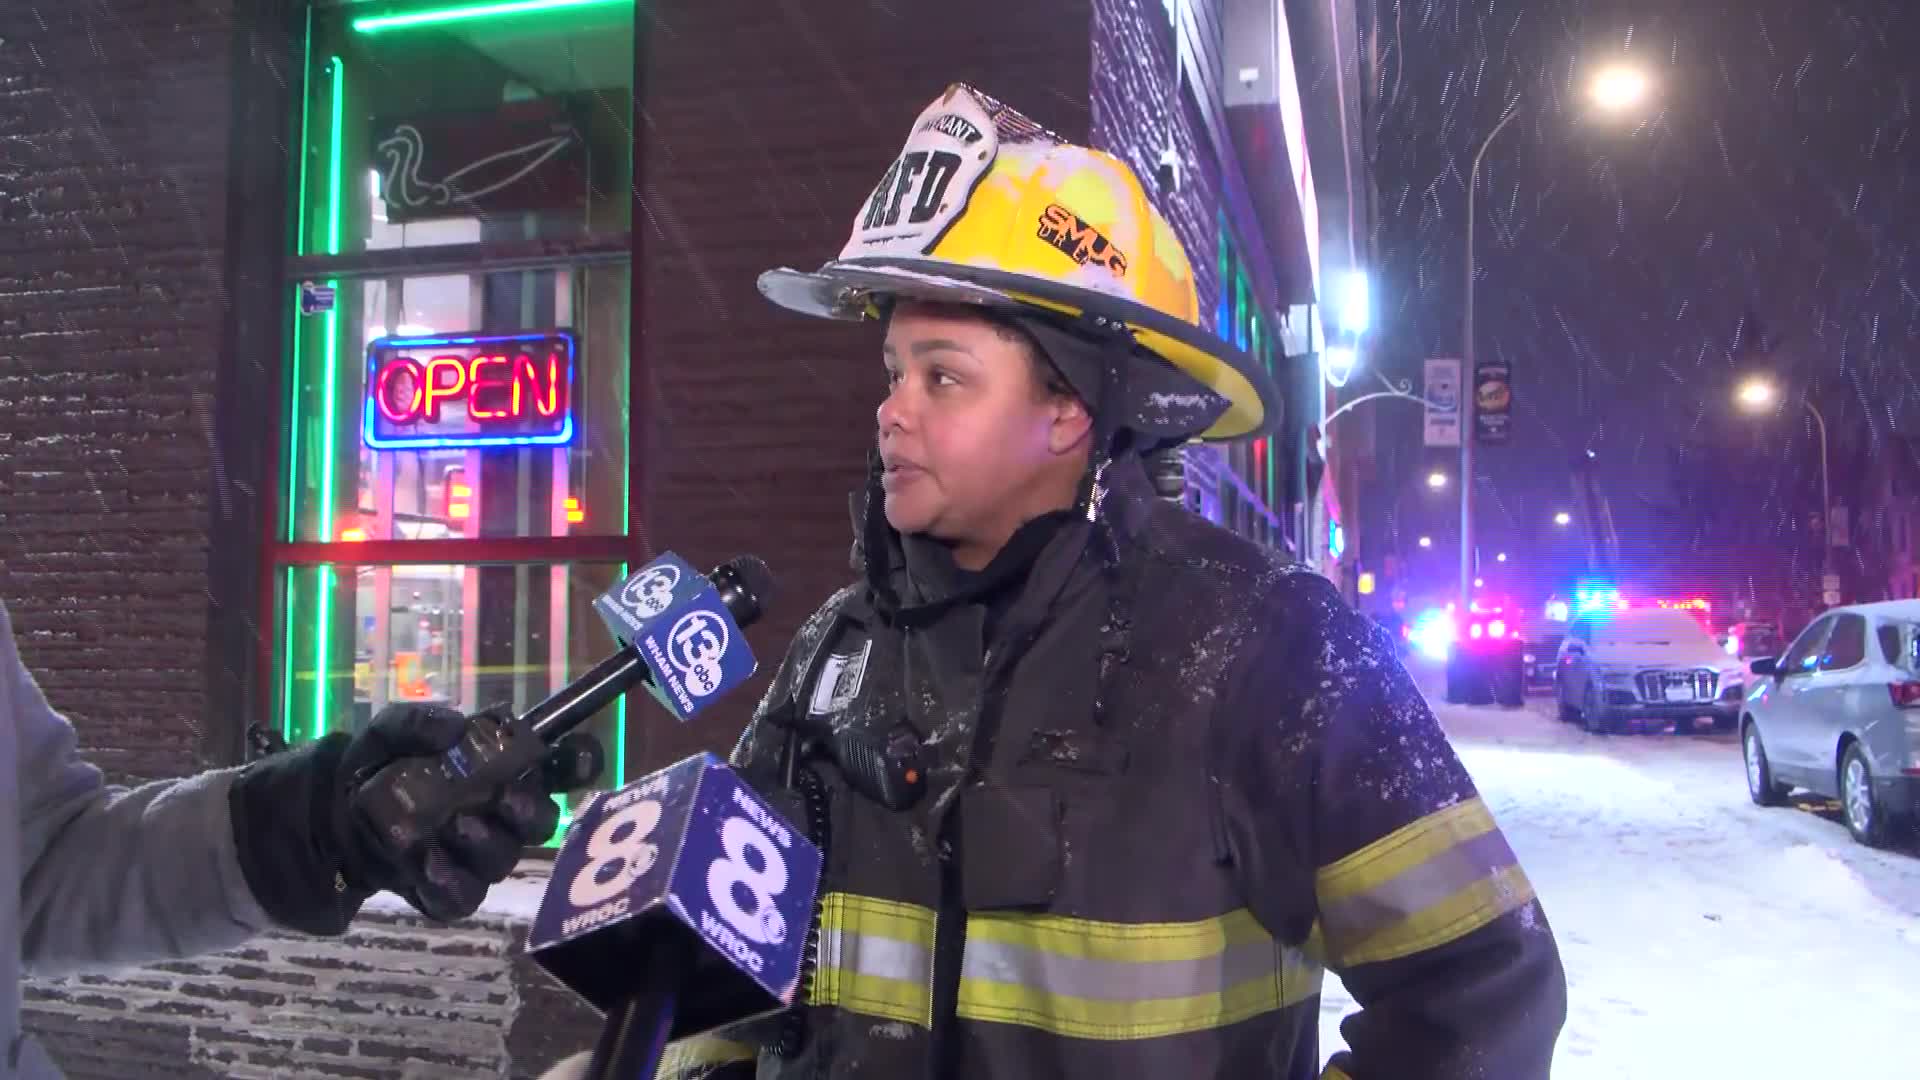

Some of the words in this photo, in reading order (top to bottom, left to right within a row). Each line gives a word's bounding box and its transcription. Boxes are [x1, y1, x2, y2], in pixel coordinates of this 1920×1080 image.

[377, 353, 557, 424] OPEN
[676, 615, 721, 668] 13
[645, 634, 672, 679] WHAM
[669, 675, 694, 713] NEWS
[694, 664, 714, 691] abc
[733, 787, 792, 848] NEWS
[568, 800, 662, 908] 8
[707, 816, 789, 945] 8
[562, 897, 631, 934] WROC
[700, 910, 764, 972] WROC
